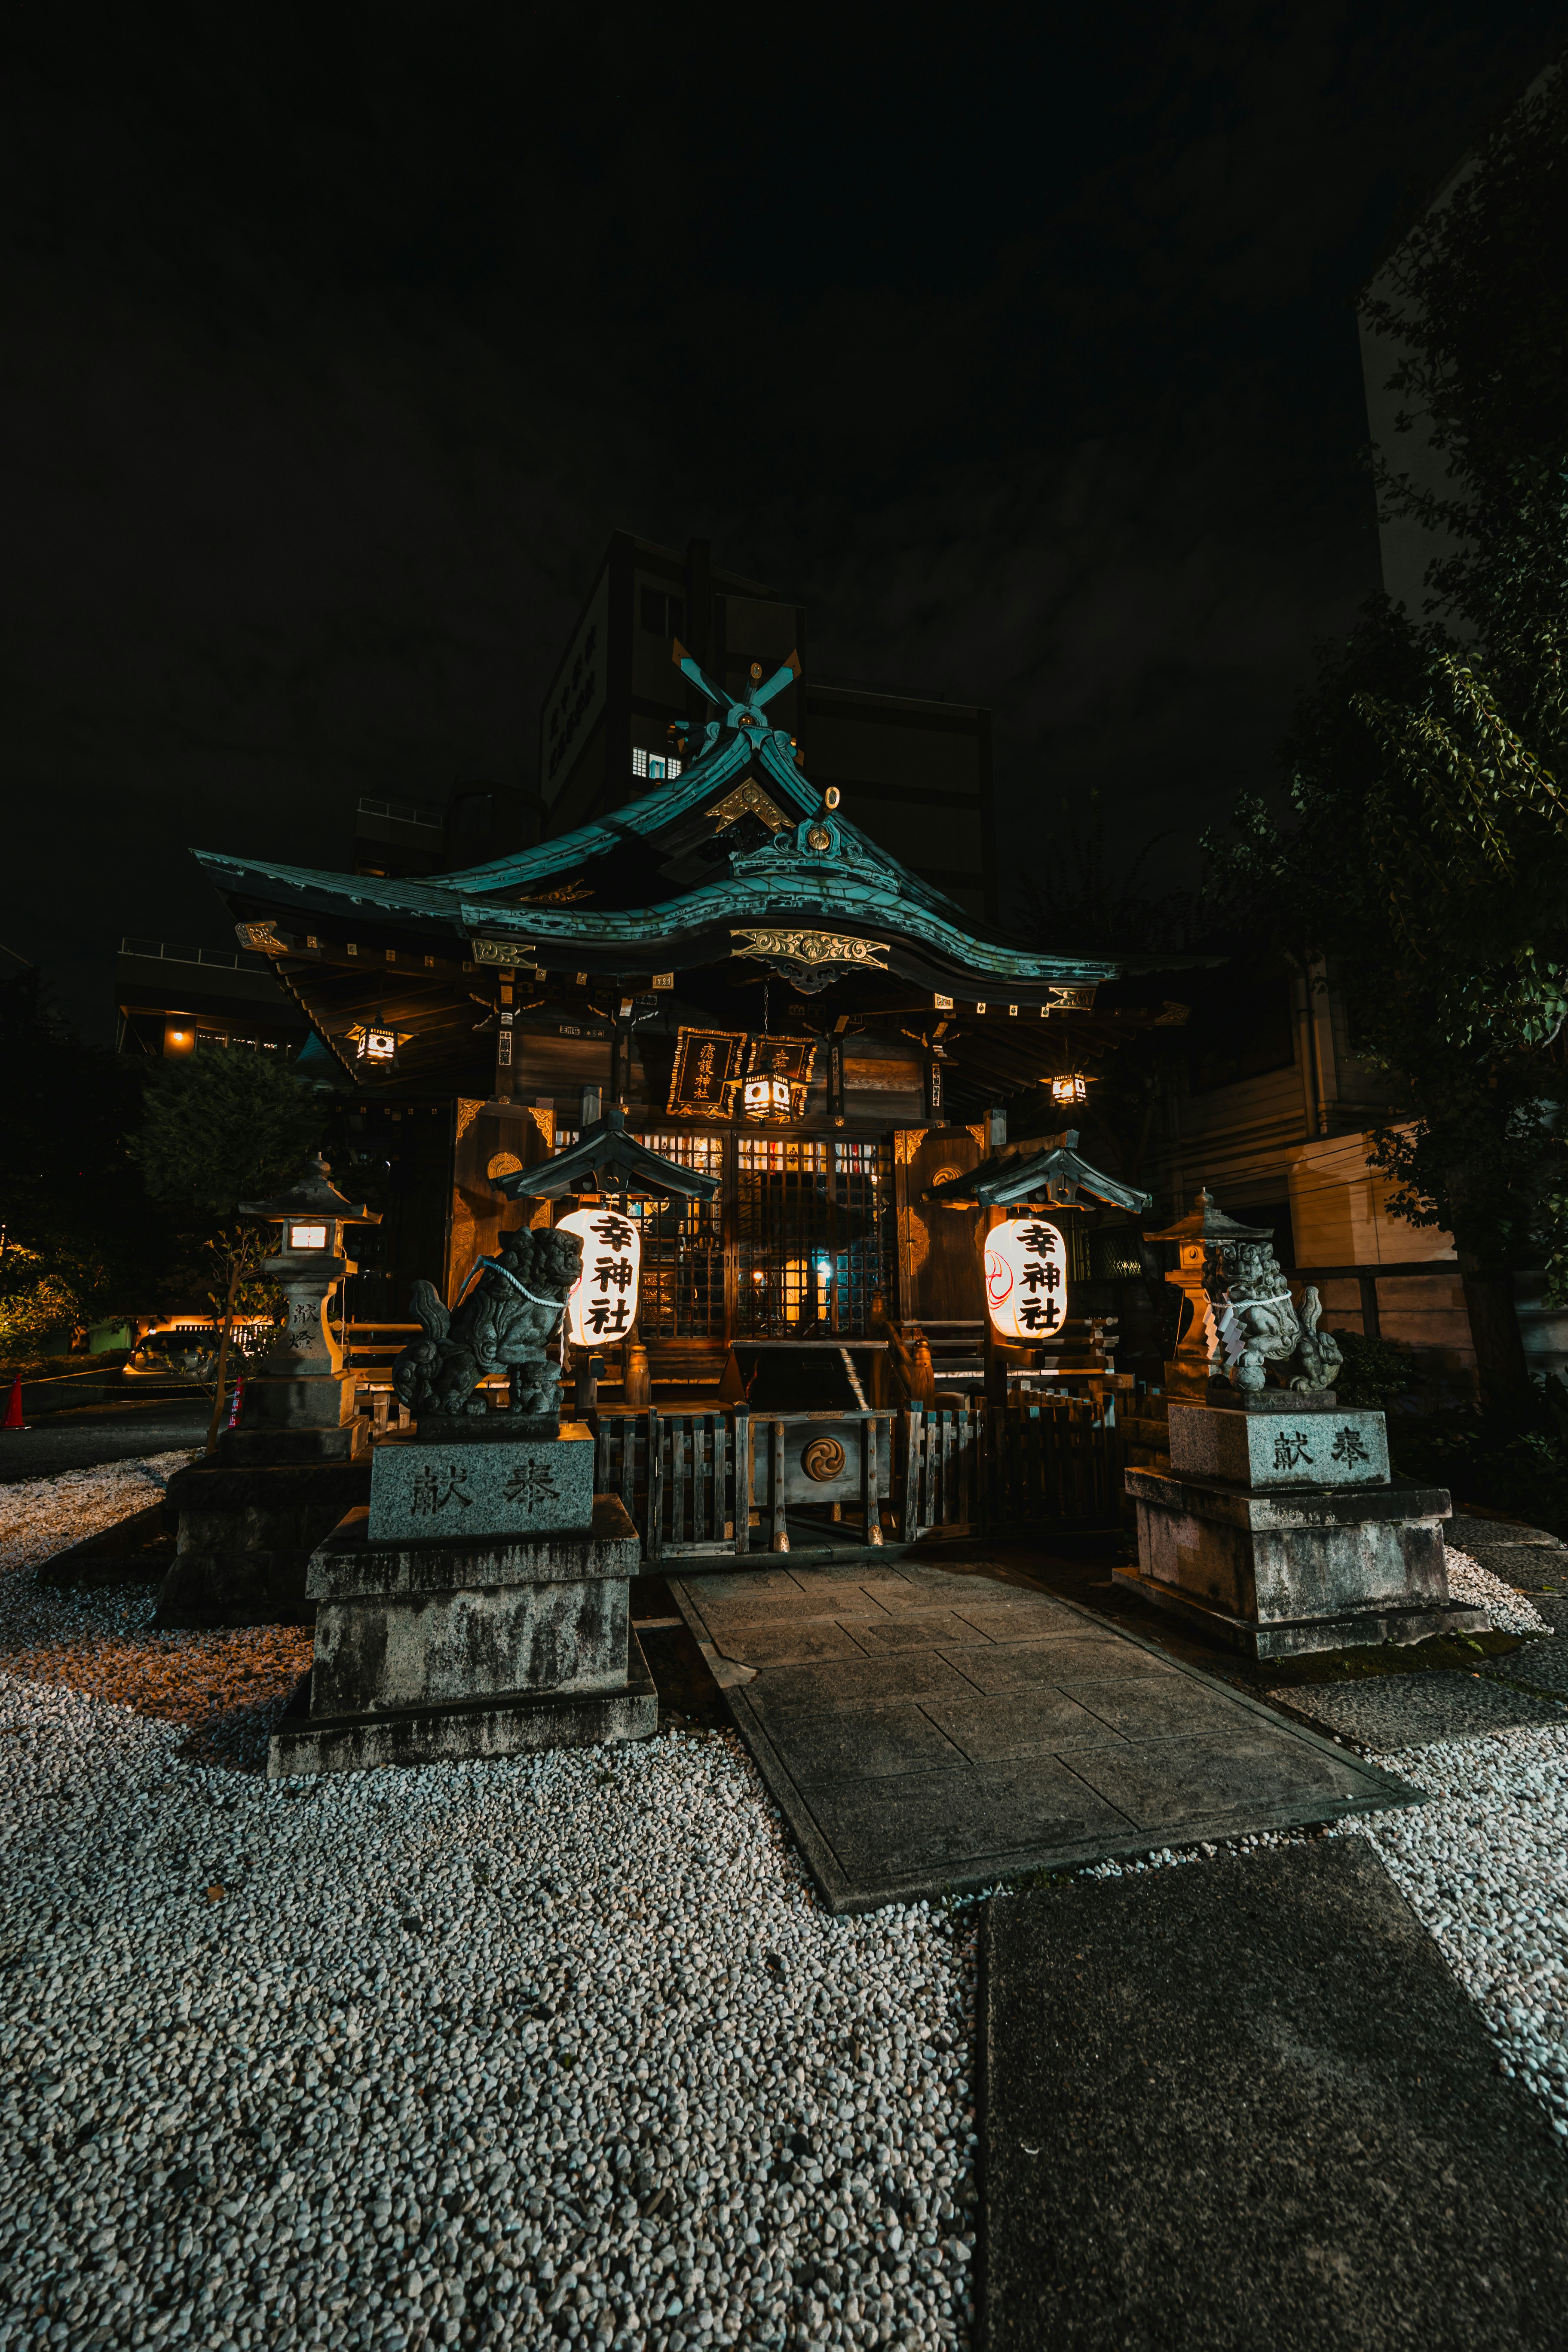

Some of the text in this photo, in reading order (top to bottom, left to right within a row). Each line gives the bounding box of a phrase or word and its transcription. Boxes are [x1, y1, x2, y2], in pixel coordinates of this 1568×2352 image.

[693, 1043, 716, 1099] 瘡護神社
[584, 1216, 634, 1335] 幸神社
[1016, 1224, 1061, 1331] 幸神社
